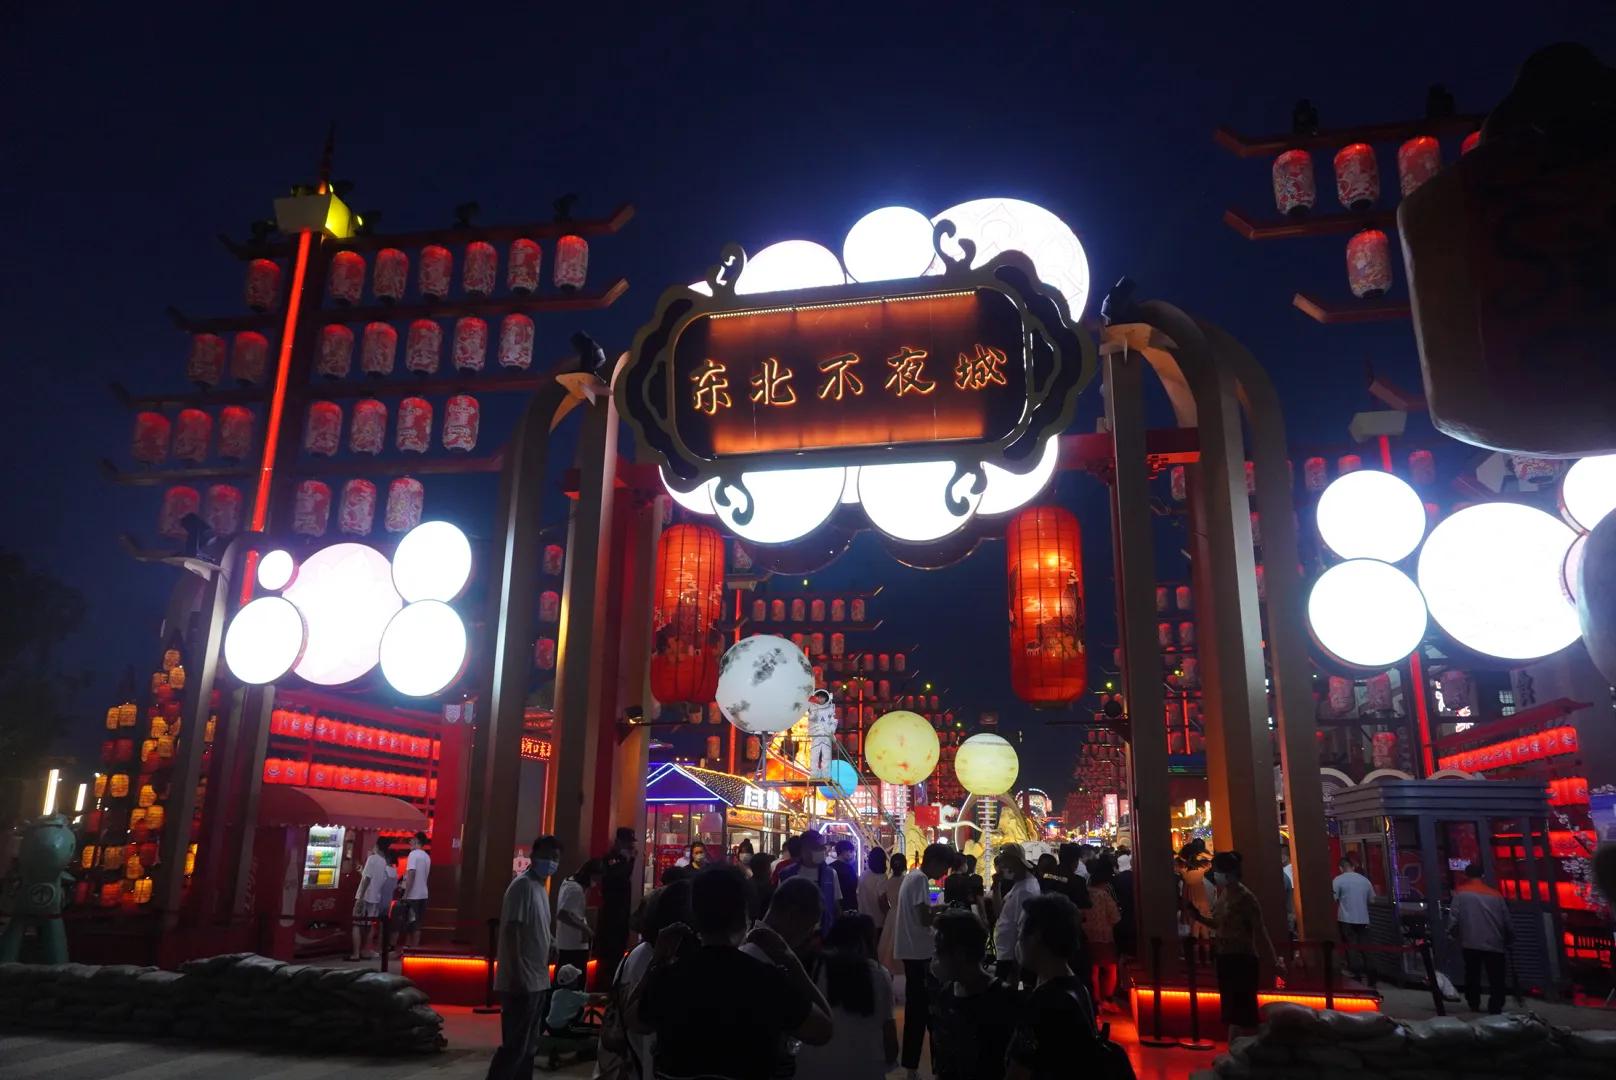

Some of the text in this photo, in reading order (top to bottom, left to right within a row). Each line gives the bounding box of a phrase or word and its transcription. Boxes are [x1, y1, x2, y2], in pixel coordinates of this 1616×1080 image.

[690, 344, 1007, 415] 东北不夜城
